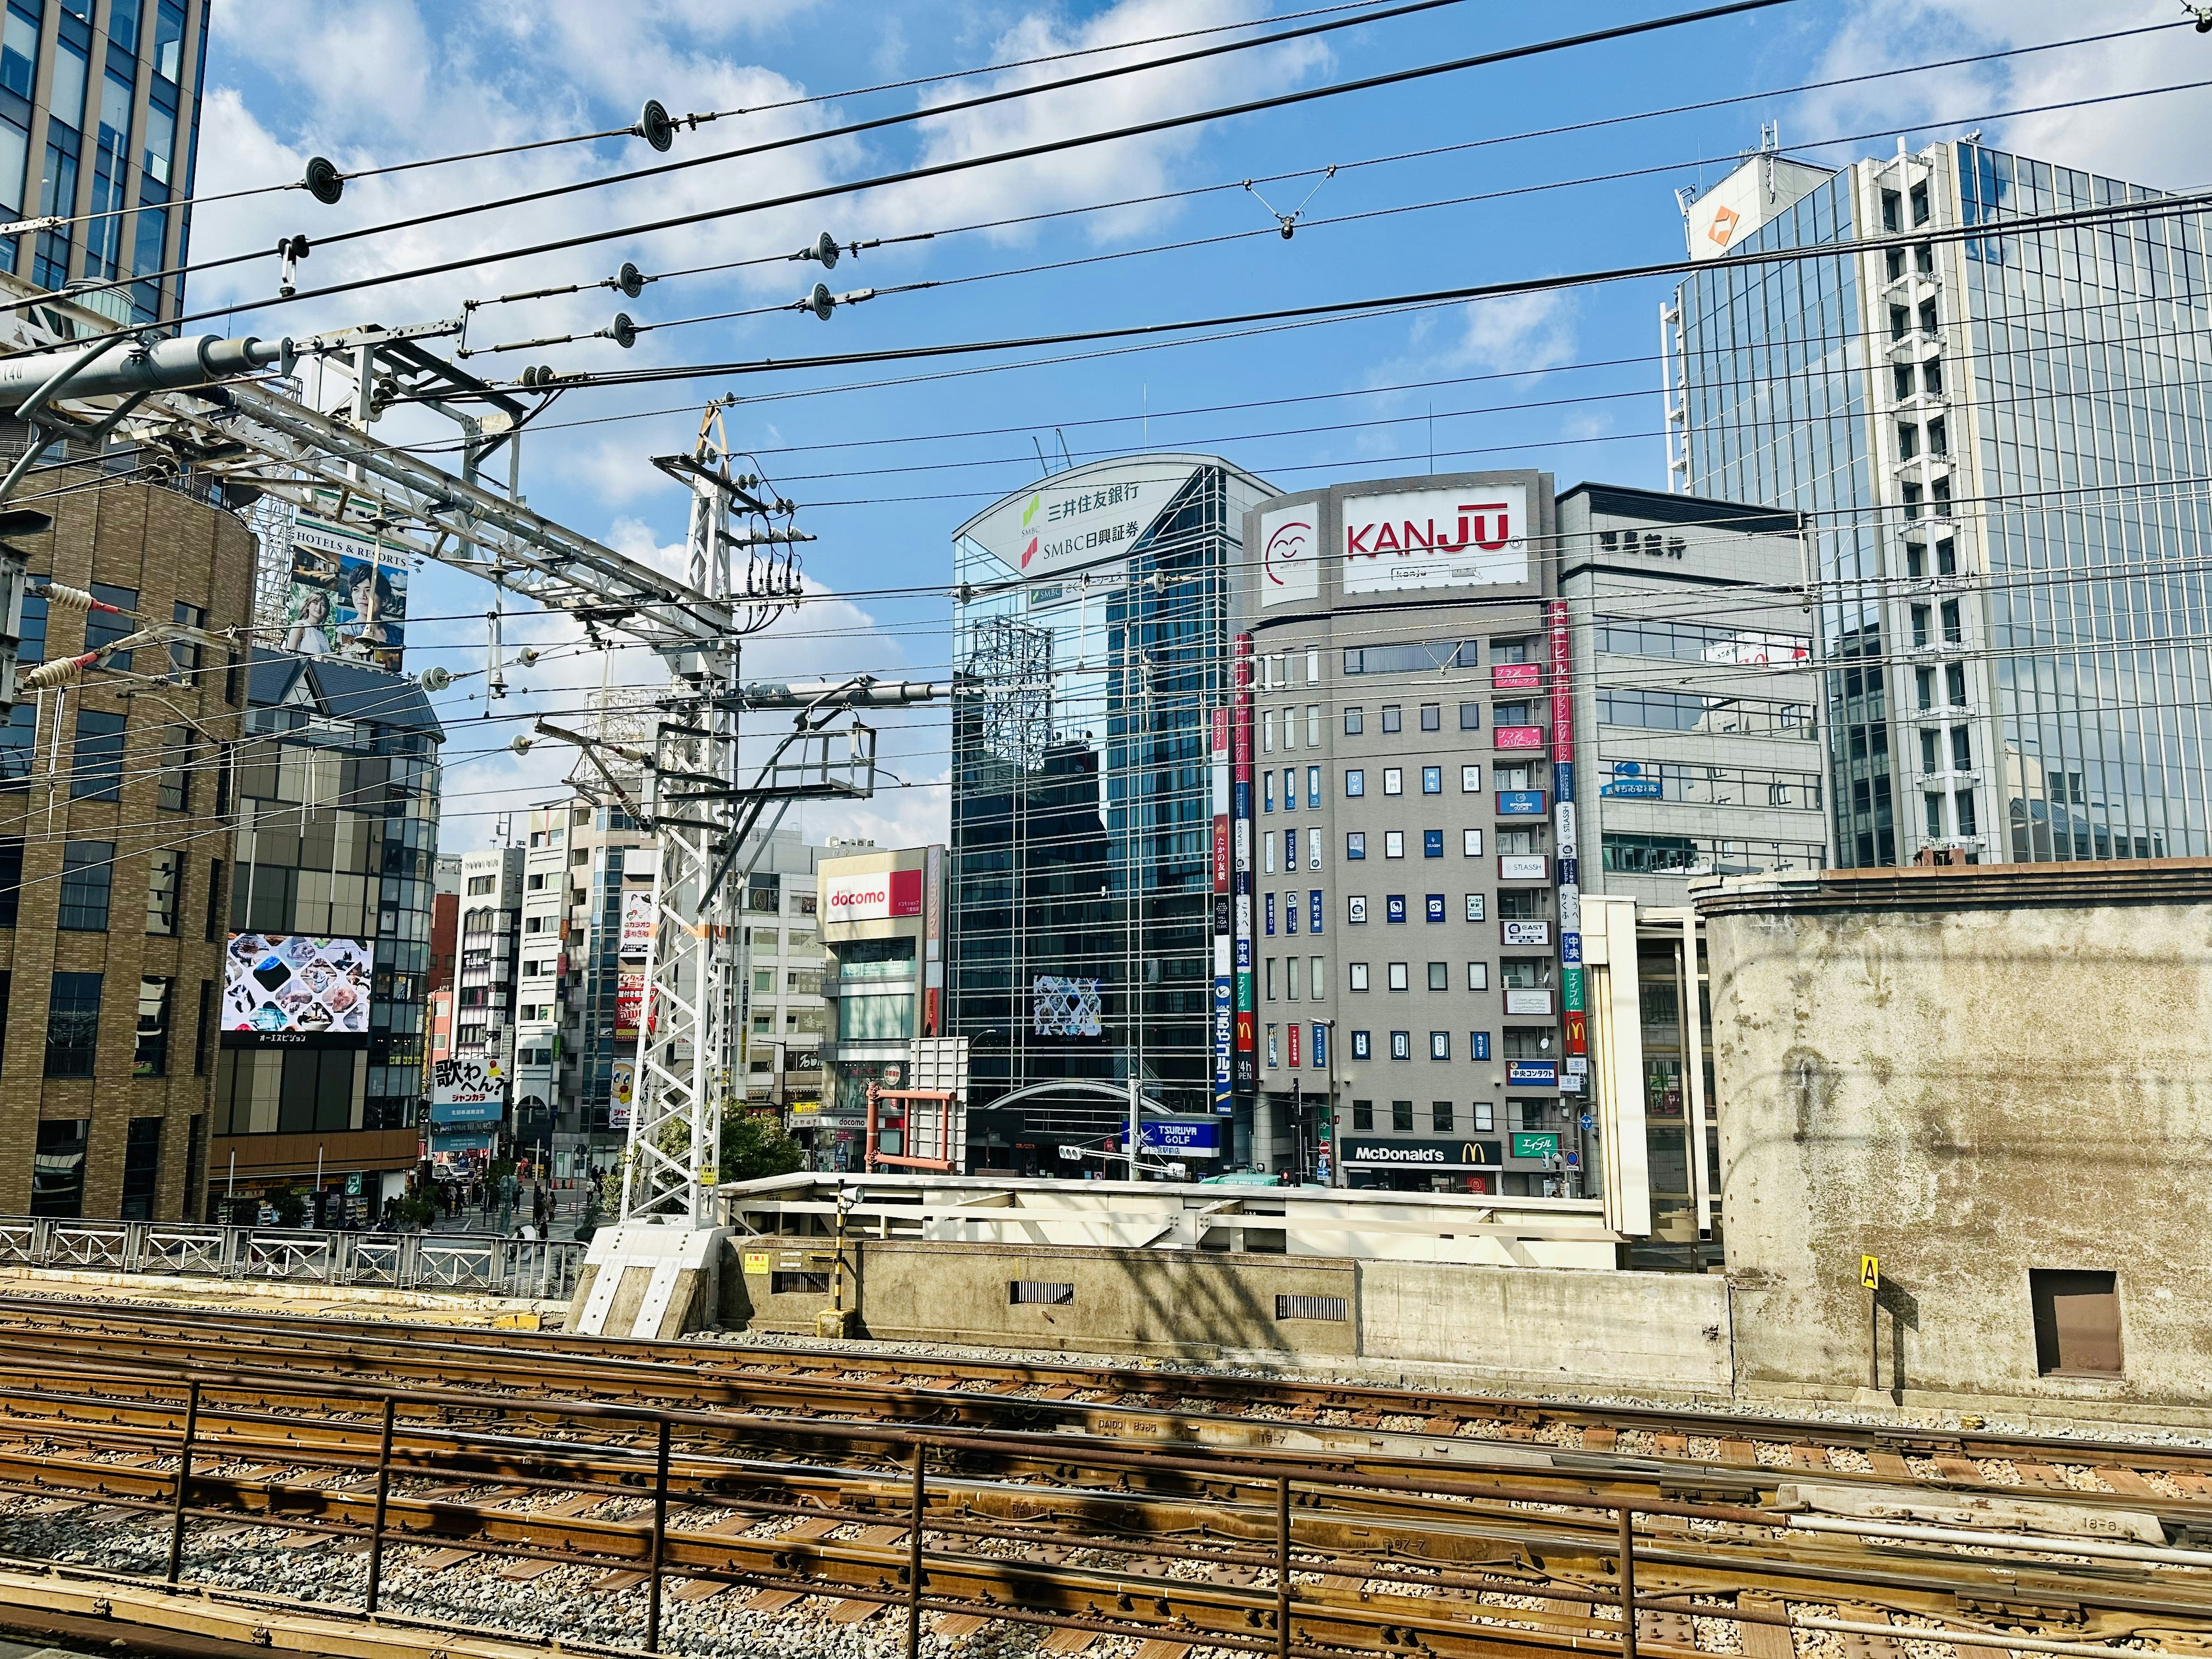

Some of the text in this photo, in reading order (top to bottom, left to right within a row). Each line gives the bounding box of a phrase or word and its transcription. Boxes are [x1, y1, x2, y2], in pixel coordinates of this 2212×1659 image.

[1048, 482, 1139, 523] 三井住友銀行
[1022, 526, 1040, 537] SMBC
[296, 531, 343, 550] HOTELS
[346, 545, 354, 554] &
[1044, 521, 1139, 560] SMBC日興証券
[1040, 589, 1061, 600] SMBC
[1503, 738, 1539, 747] クリニック
[1352, 775, 1359, 792] ひざ
[1427, 772, 1436, 789] 再生
[1217, 837, 1226, 881] たかの友梨
[831, 890, 885, 906] docomo
[1239, 943, 1248, 964] 中央
[1569, 936, 1579, 959] 中央
[466, 957, 484, 966] GLOBE
[1569, 973, 1580, 1007] エイブル
[1216, 1009, 1231, 1082] つるやゴルフ
[435, 1059, 481, 1087] 歌わ
[452, 1093, 486, 1102] ジャンカラ
[839, 1118, 865, 1126] docomo
[1158, 1125, 1197, 1136] TSURUYA
[1165, 1136, 1190, 1145] GOLF
[1522, 1138, 1552, 1150] エイブル
[1356, 1147, 1444, 1162] McDonald's
[1863, 1260, 1876, 1285] A
[1099, 1420, 1123, 1429] DAIDO
